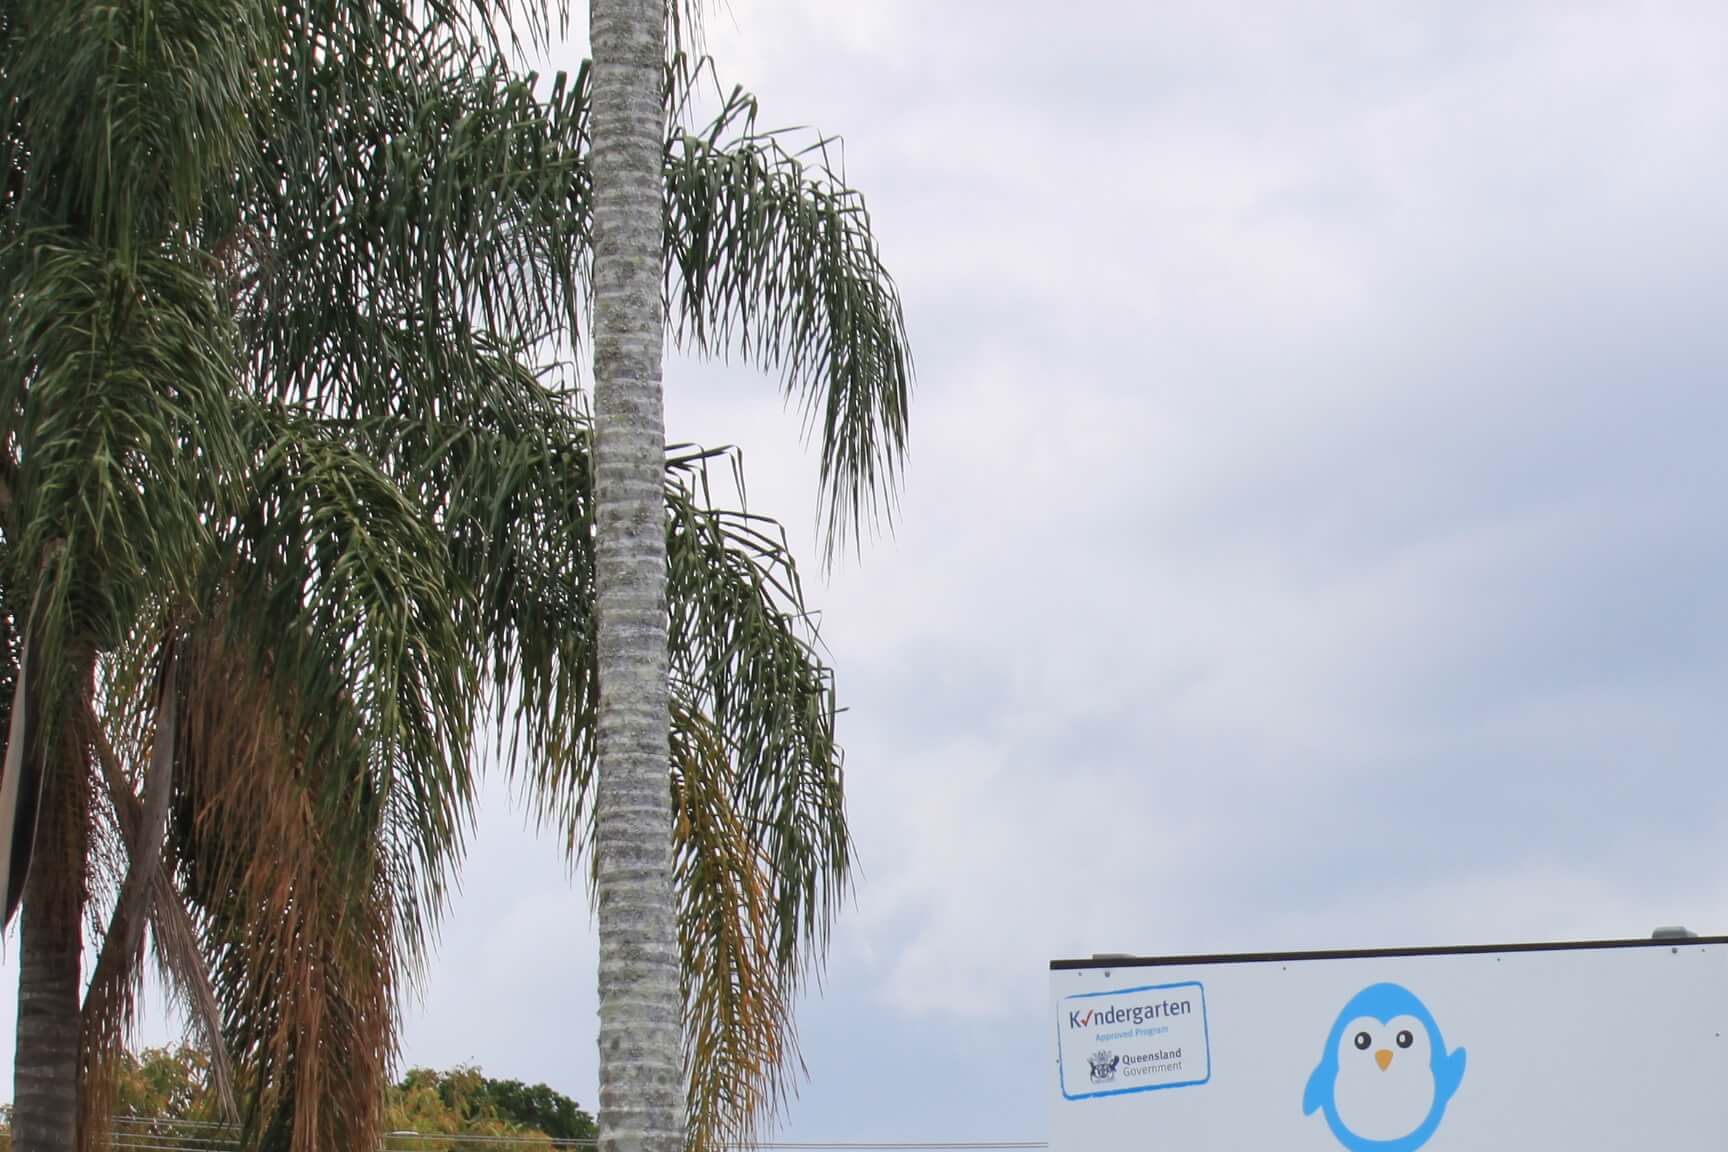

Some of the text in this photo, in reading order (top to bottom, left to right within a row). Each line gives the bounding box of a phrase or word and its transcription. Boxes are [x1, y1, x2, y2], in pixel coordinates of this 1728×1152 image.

[1096, 1027, 1133, 1042] Approved
[1122, 1048, 1181, 1065] Queensland
[1123, 1061, 1182, 1077] Government
